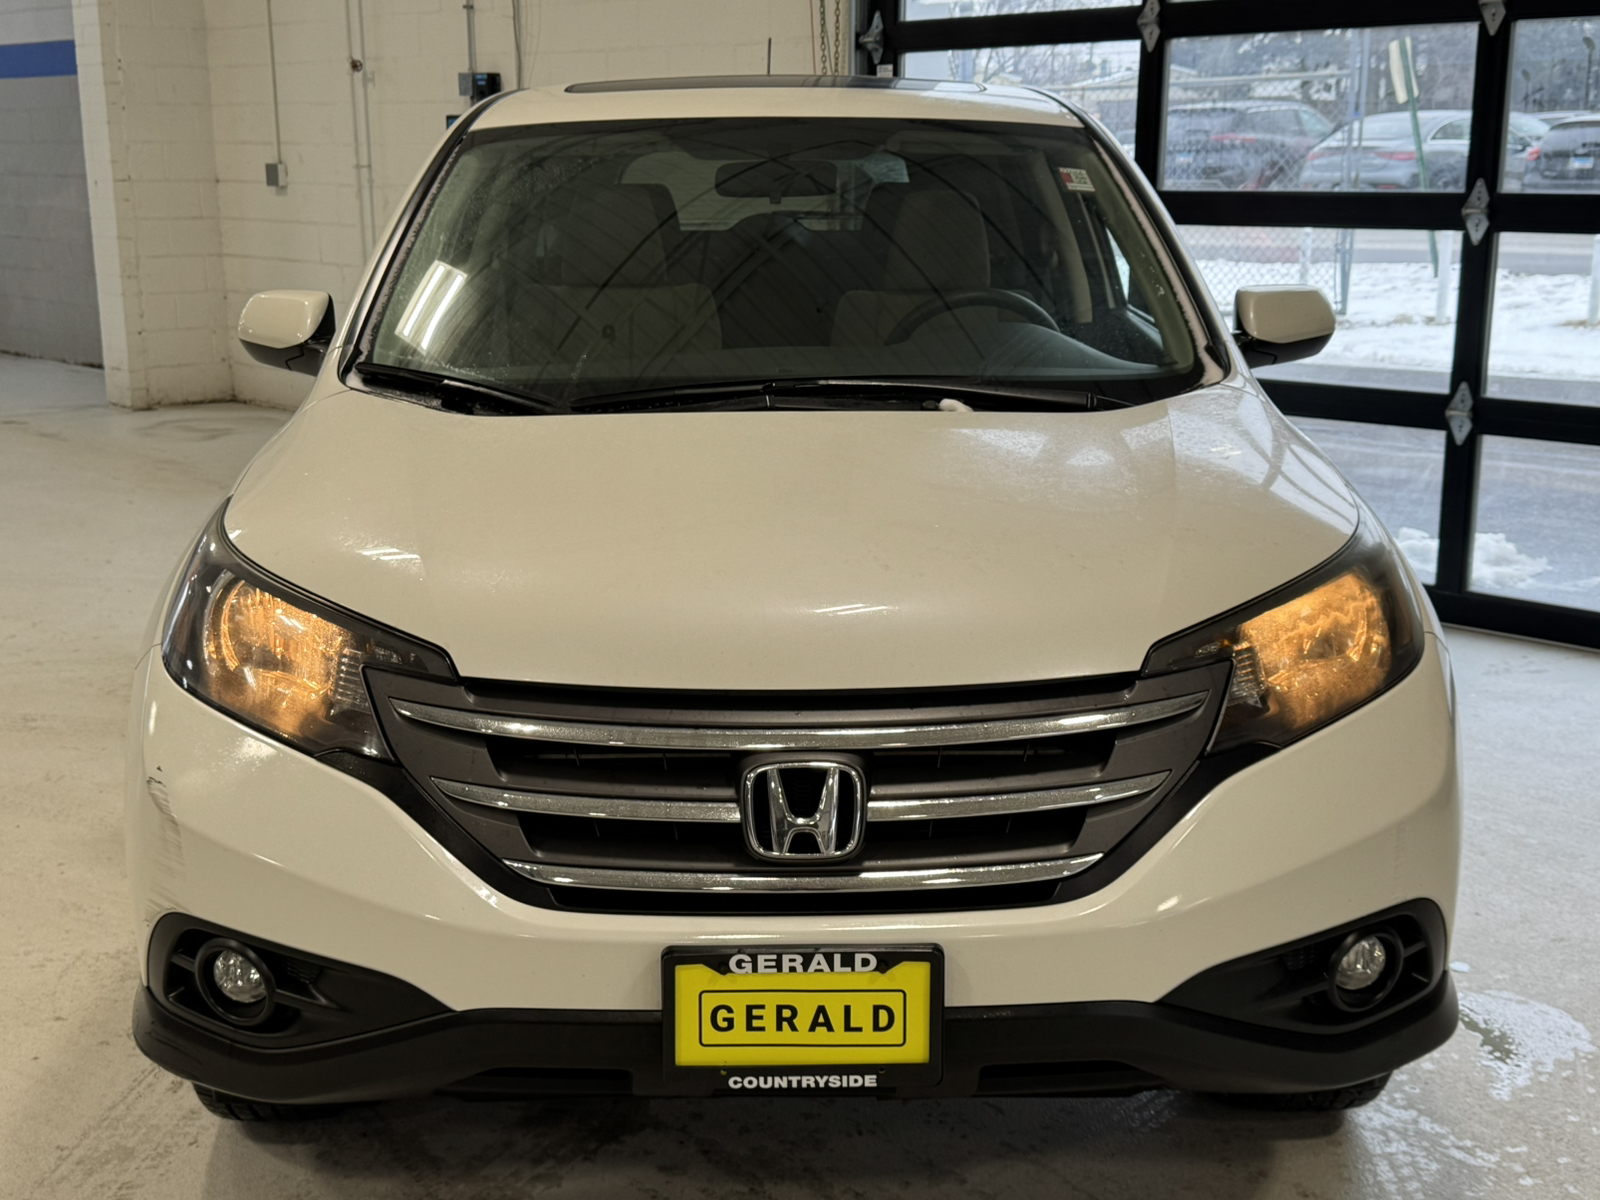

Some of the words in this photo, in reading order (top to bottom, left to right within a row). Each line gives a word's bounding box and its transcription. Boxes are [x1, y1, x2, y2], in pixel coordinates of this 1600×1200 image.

[728, 953, 878, 974] GERALD
[709, 1004, 896, 1033] GERALD
[727, 1074, 878, 1089] COUNTRYSIDE
